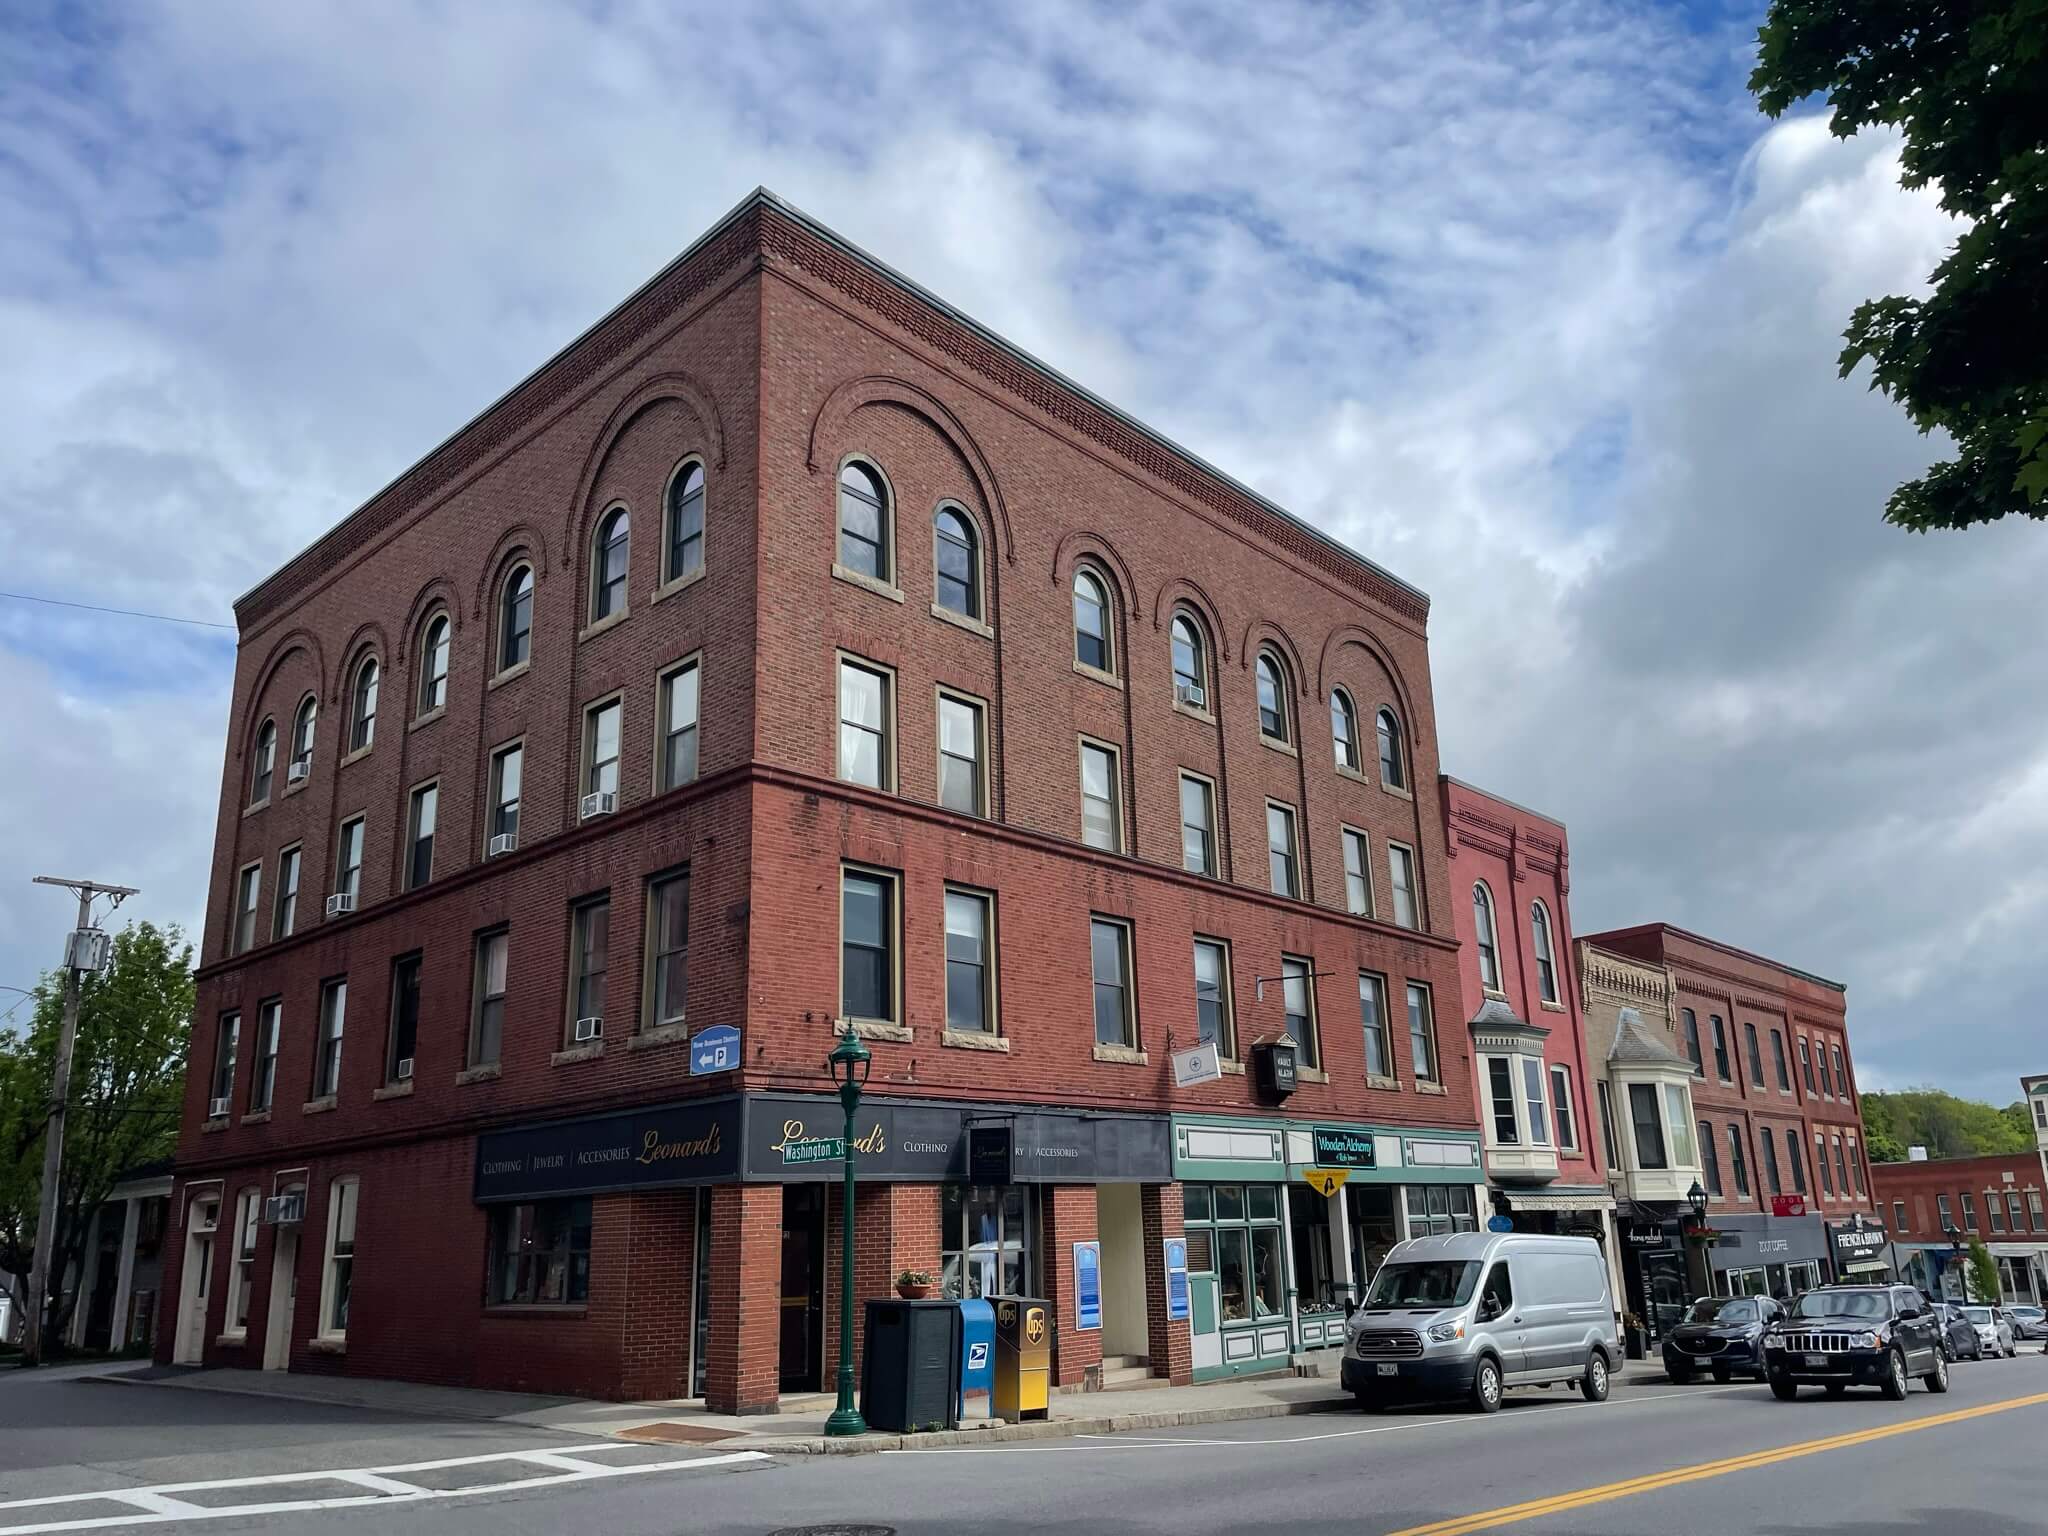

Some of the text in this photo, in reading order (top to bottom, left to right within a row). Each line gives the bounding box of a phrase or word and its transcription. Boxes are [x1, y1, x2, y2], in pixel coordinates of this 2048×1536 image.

[635, 1122, 721, 1164] Leonard's
[785, 1140, 845, 1161] Washington St
[1035, 1147, 1079, 1157] ACCESSORIES
[1317, 1136, 1345, 1151] Wooden
[1345, 1137, 1372, 1157] Alchemy
[482, 1147, 631, 1175] CLOTHING JEWELRY ACCESSORIES
[1837, 1233, 1861, 1247] FRENCH
[1865, 1232, 1884, 1245] BROWN
[1000, 1309, 1015, 1325] ups
[1028, 1319, 1043, 1339] ups
